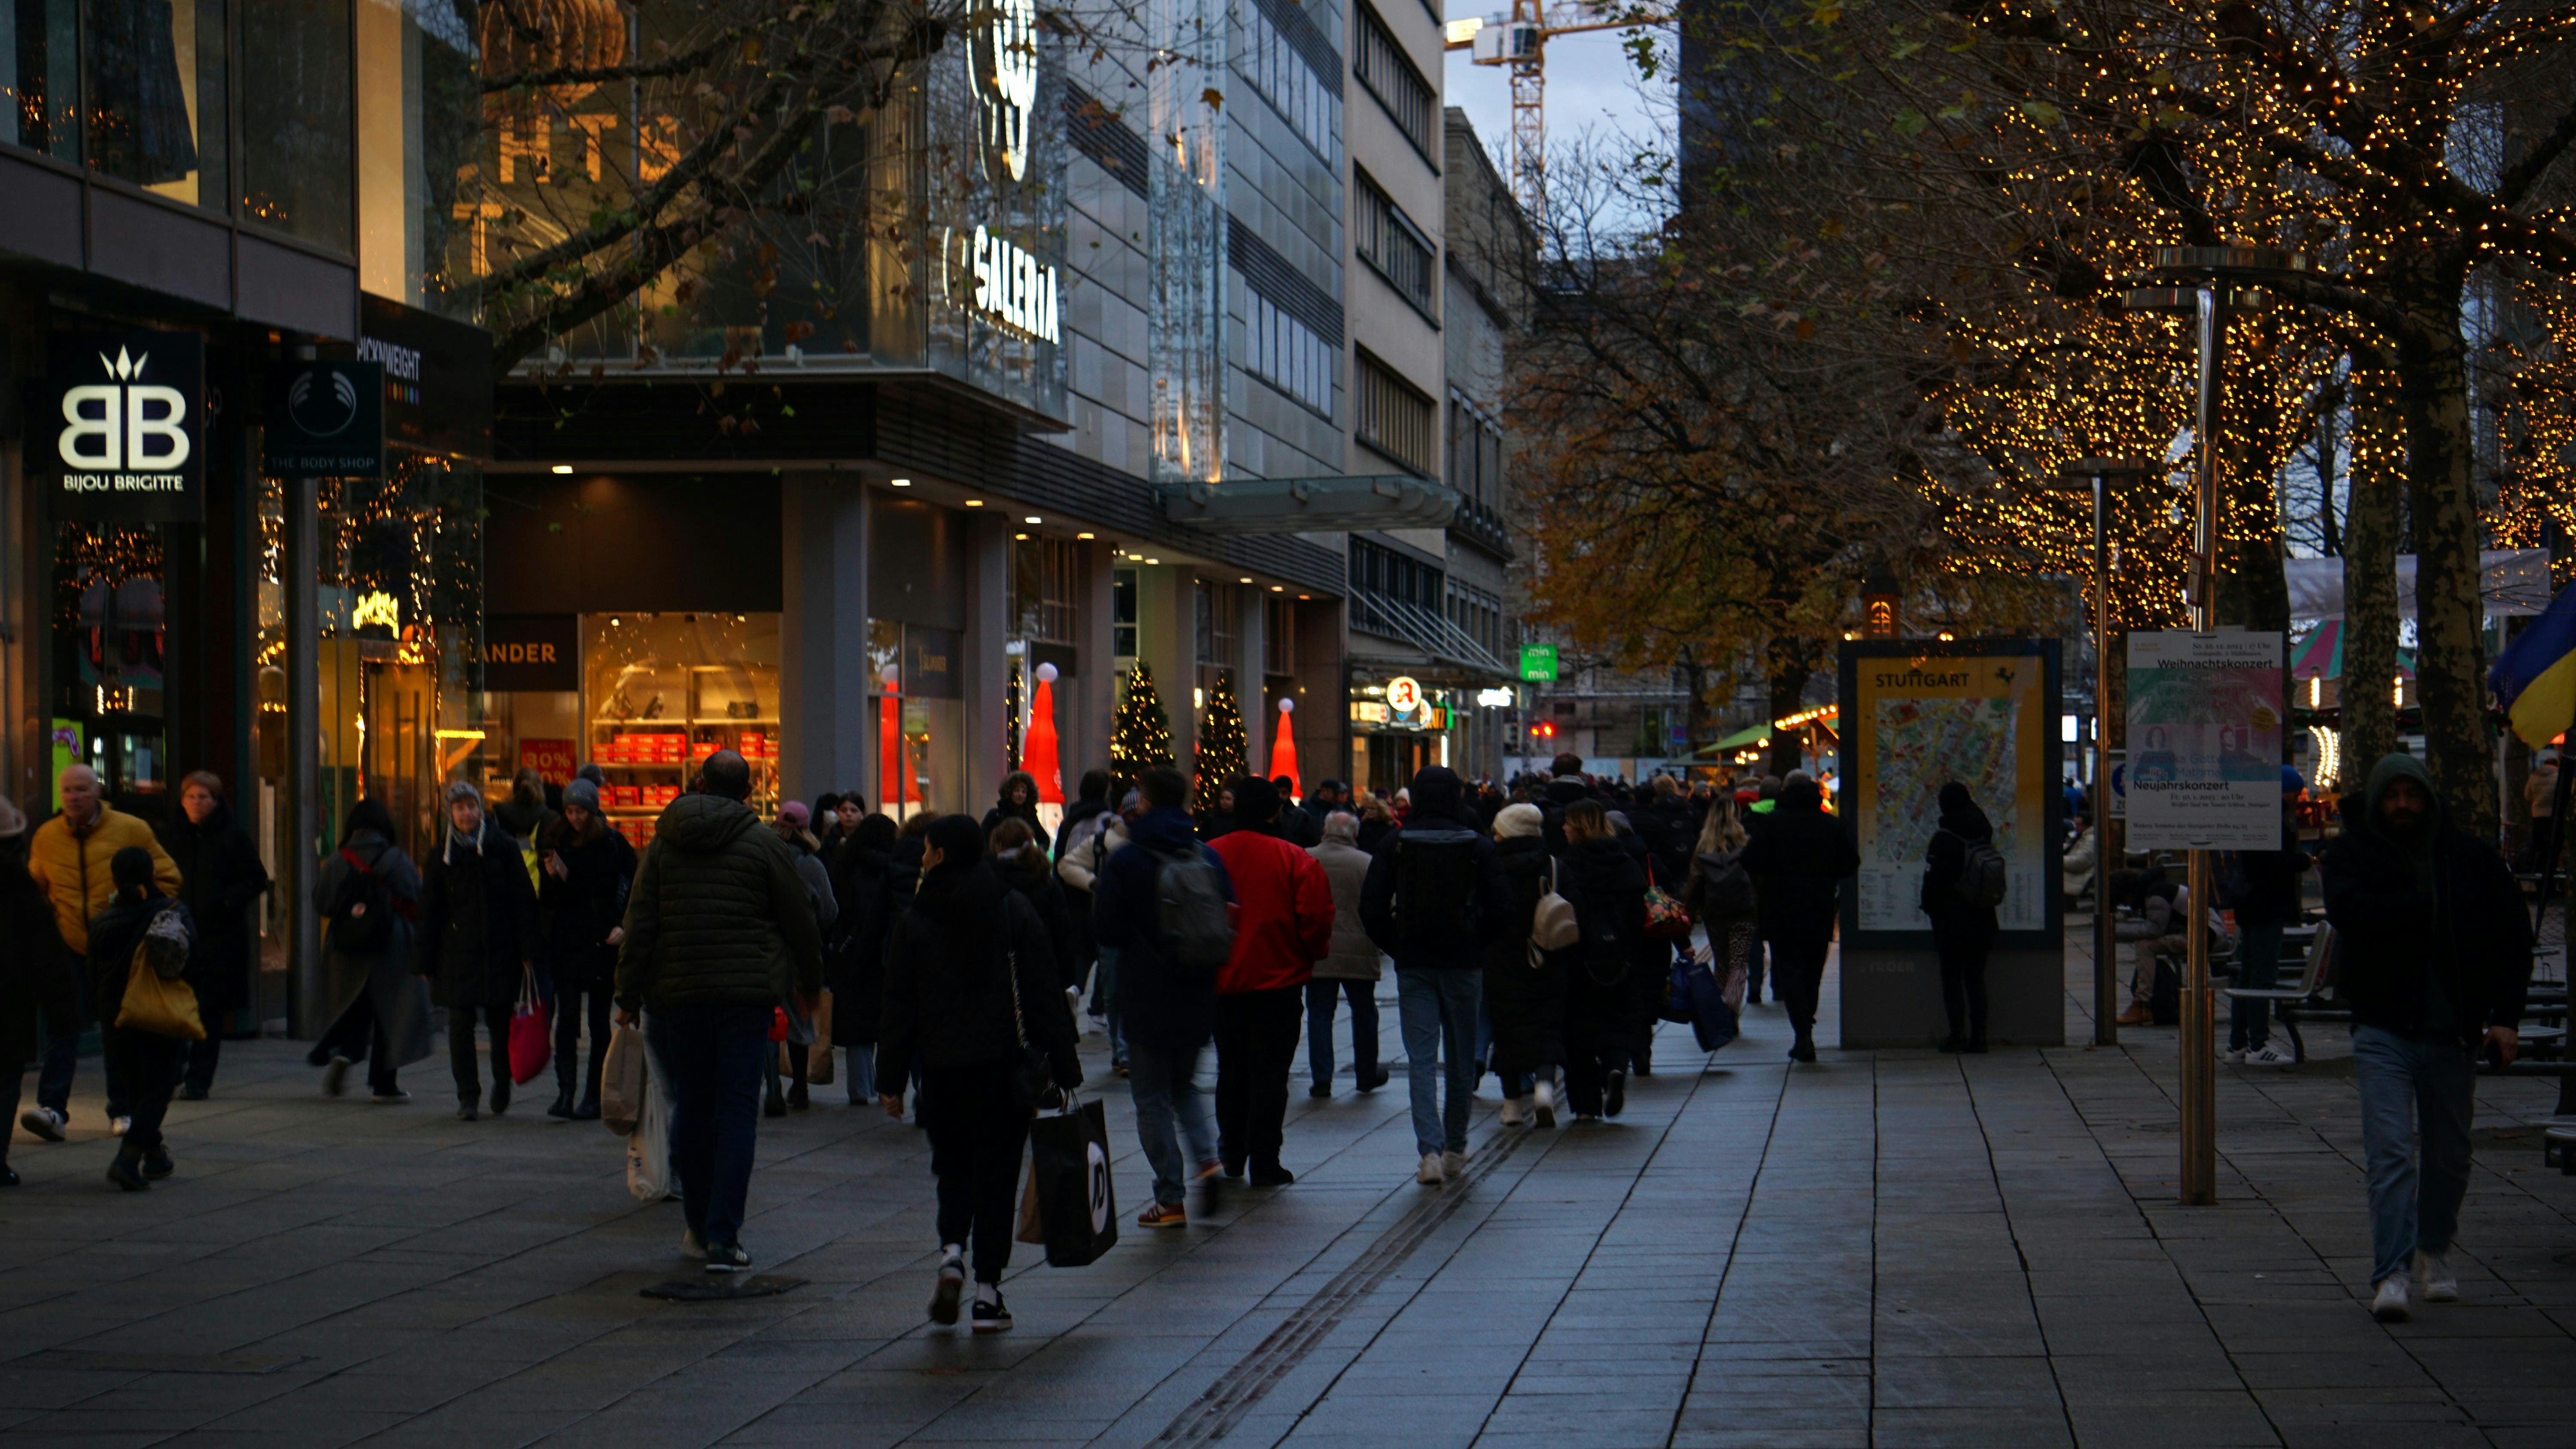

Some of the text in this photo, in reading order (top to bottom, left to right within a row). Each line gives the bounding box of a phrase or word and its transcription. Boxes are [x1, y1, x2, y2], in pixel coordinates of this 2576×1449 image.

[974, 224, 1059, 345] GALERIA
[271, 457, 375, 470] THE BODY SHOP
[64, 474, 185, 493] BIJOU BRIGITTE
[1528, 646, 1549, 657] min
[2157, 659, 2273, 669] Weihnachtskonzert
[1528, 668, 1549, 679] min
[1876, 670, 1970, 688] STUTTGART
[526, 752, 571, 768] 30%
[2133, 780, 2229, 791] Neujahrskonzert
